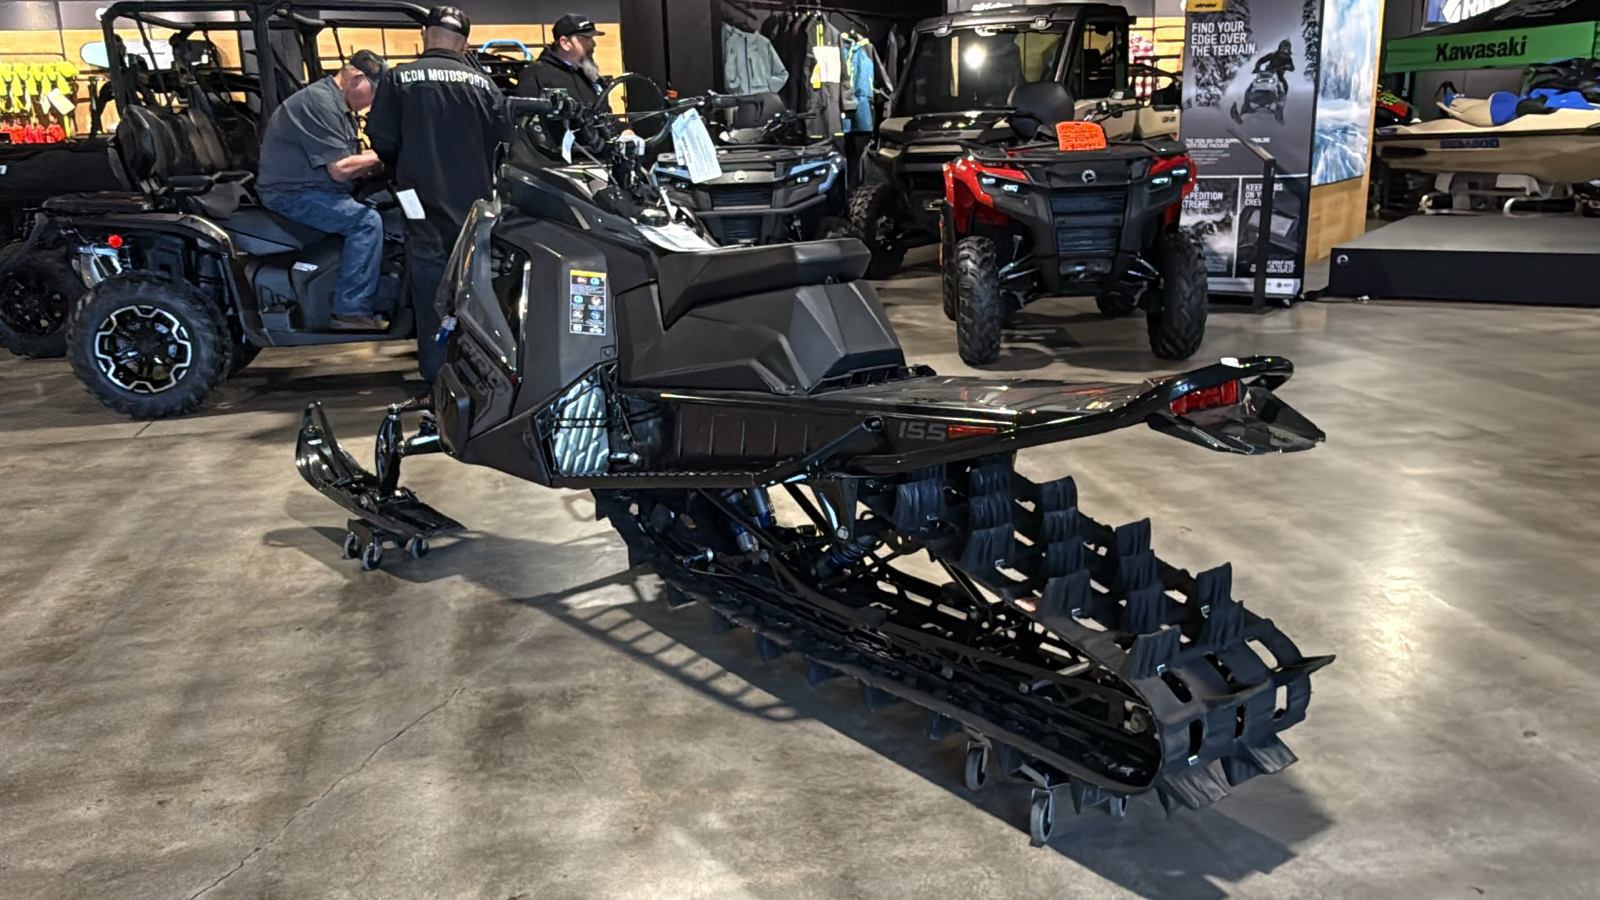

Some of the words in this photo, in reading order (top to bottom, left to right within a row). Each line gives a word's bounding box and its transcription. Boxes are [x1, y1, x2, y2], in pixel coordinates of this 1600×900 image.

[1191, 22, 1215, 33] FIND
[1217, 21, 1245, 33] YOUR
[1191, 34, 1217, 45] EDGE
[1220, 32, 1247, 44] OVER
[1191, 45, 1211, 57] THE
[1212, 43, 1258, 56] TERRAIN.
[1435, 35, 1528, 62] Kawasaki
[400, 69, 426, 83] ICON
[1183, 192, 1223, 200] PEDITION
